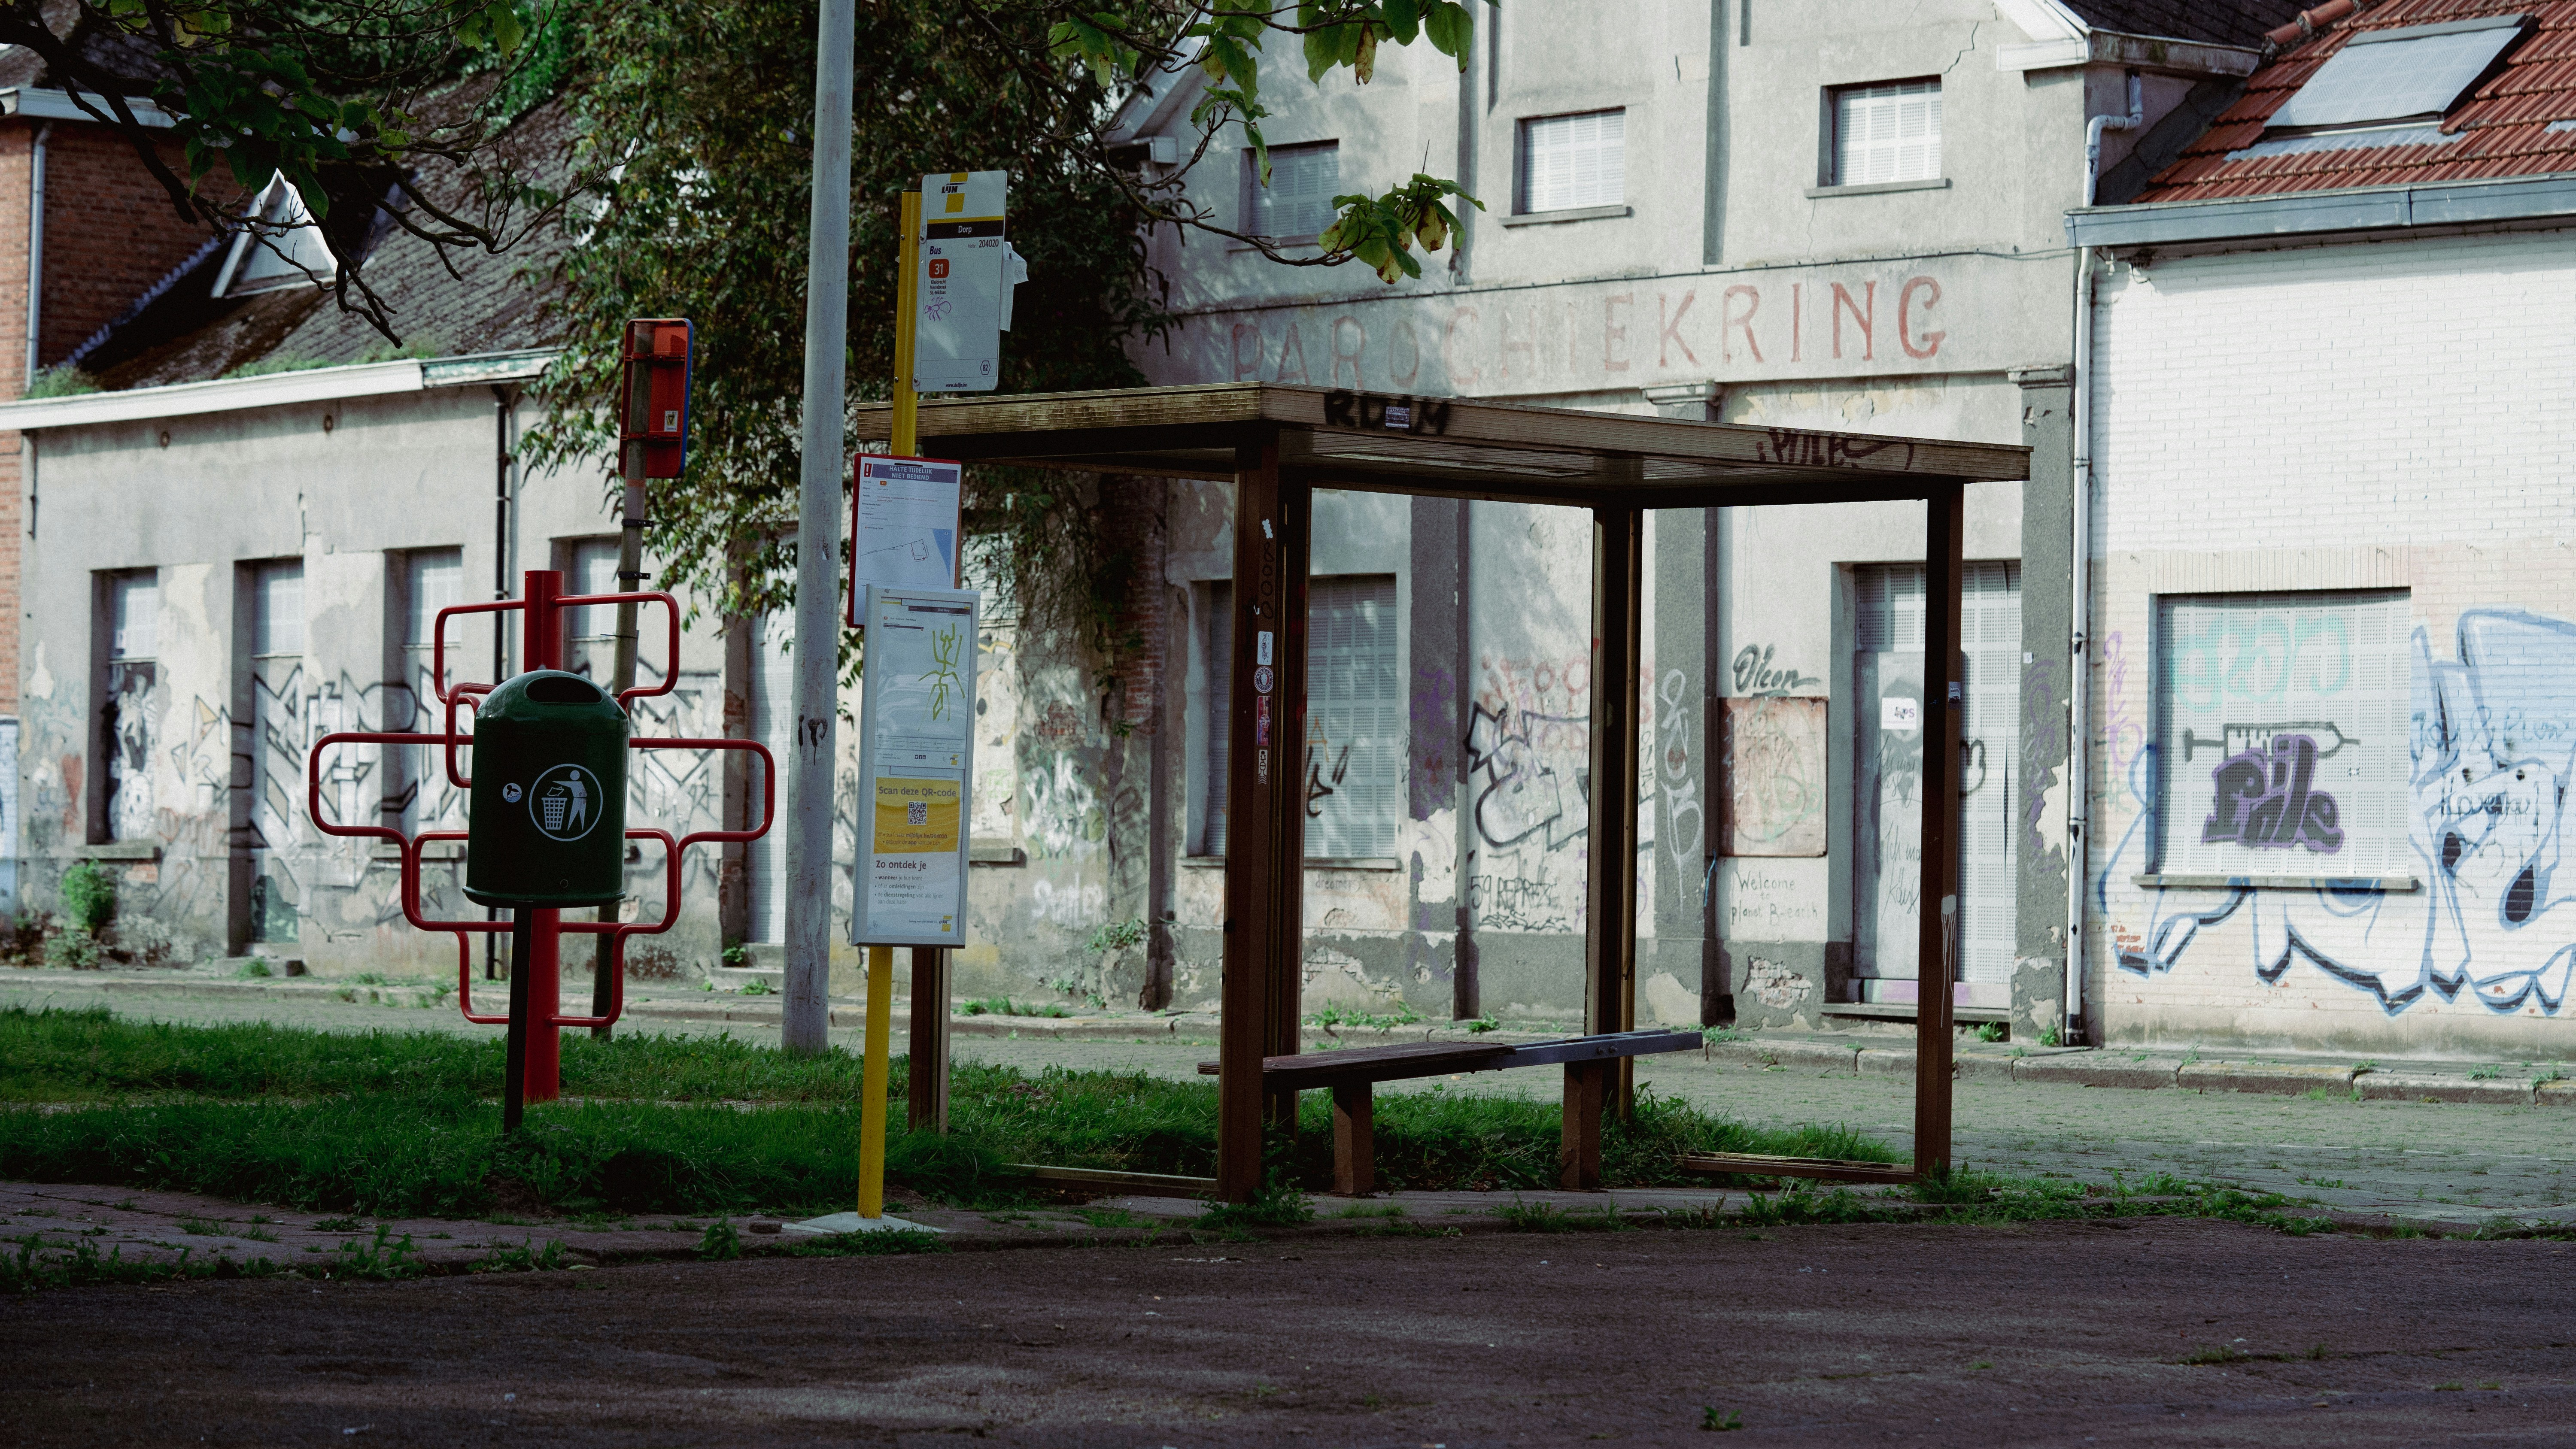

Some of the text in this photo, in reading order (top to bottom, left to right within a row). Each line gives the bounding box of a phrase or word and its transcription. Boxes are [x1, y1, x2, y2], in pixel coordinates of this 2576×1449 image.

[958, 225, 972, 234] Dorp
[979, 239, 999, 248] 204020
[930, 246, 942, 255] Bus
[934, 263, 944, 275] 31
[879, 786, 956, 797] Scan deze QR-code
[876, 860, 927, 871] Zo ontdek je
[1736, 871, 1796, 892] Welcome
